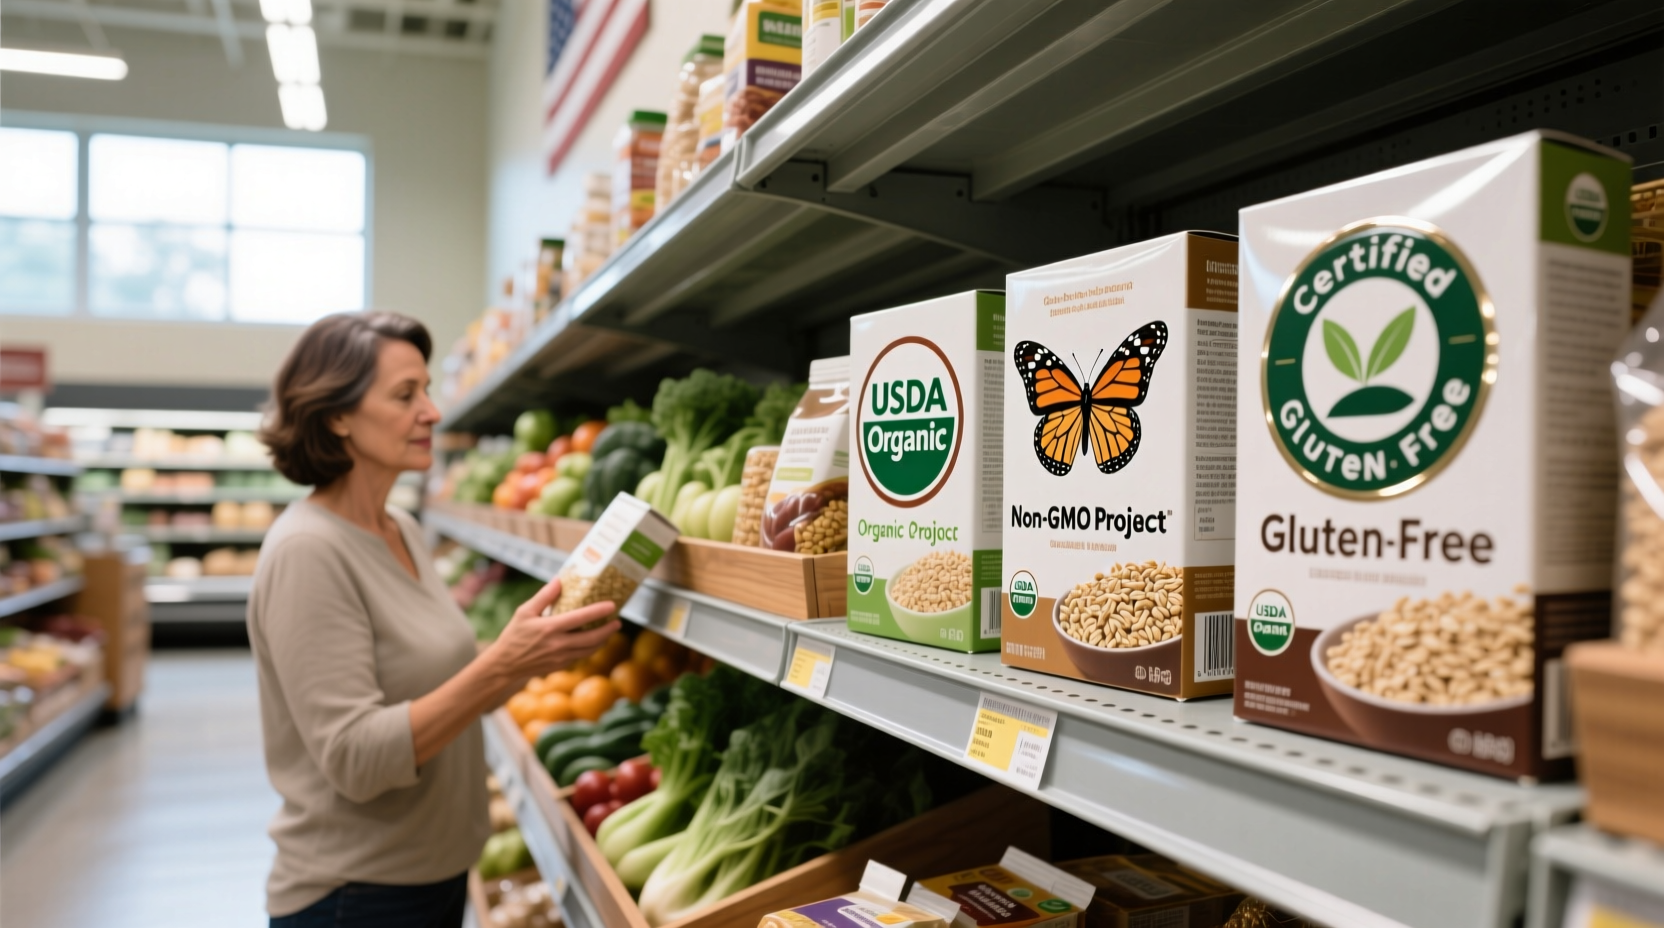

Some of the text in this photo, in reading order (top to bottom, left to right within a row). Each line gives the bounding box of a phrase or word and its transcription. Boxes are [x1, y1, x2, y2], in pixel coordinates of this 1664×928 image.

[1293, 234, 1457, 315] Certified
[872, 377, 947, 416] USDA
[867, 421, 947, 462] Organic
[1011, 504, 1091, 531] Non-GMO
[1260, 513, 1495, 565] Gluten-Free
[1256, 603, 1287, 618] USDA
